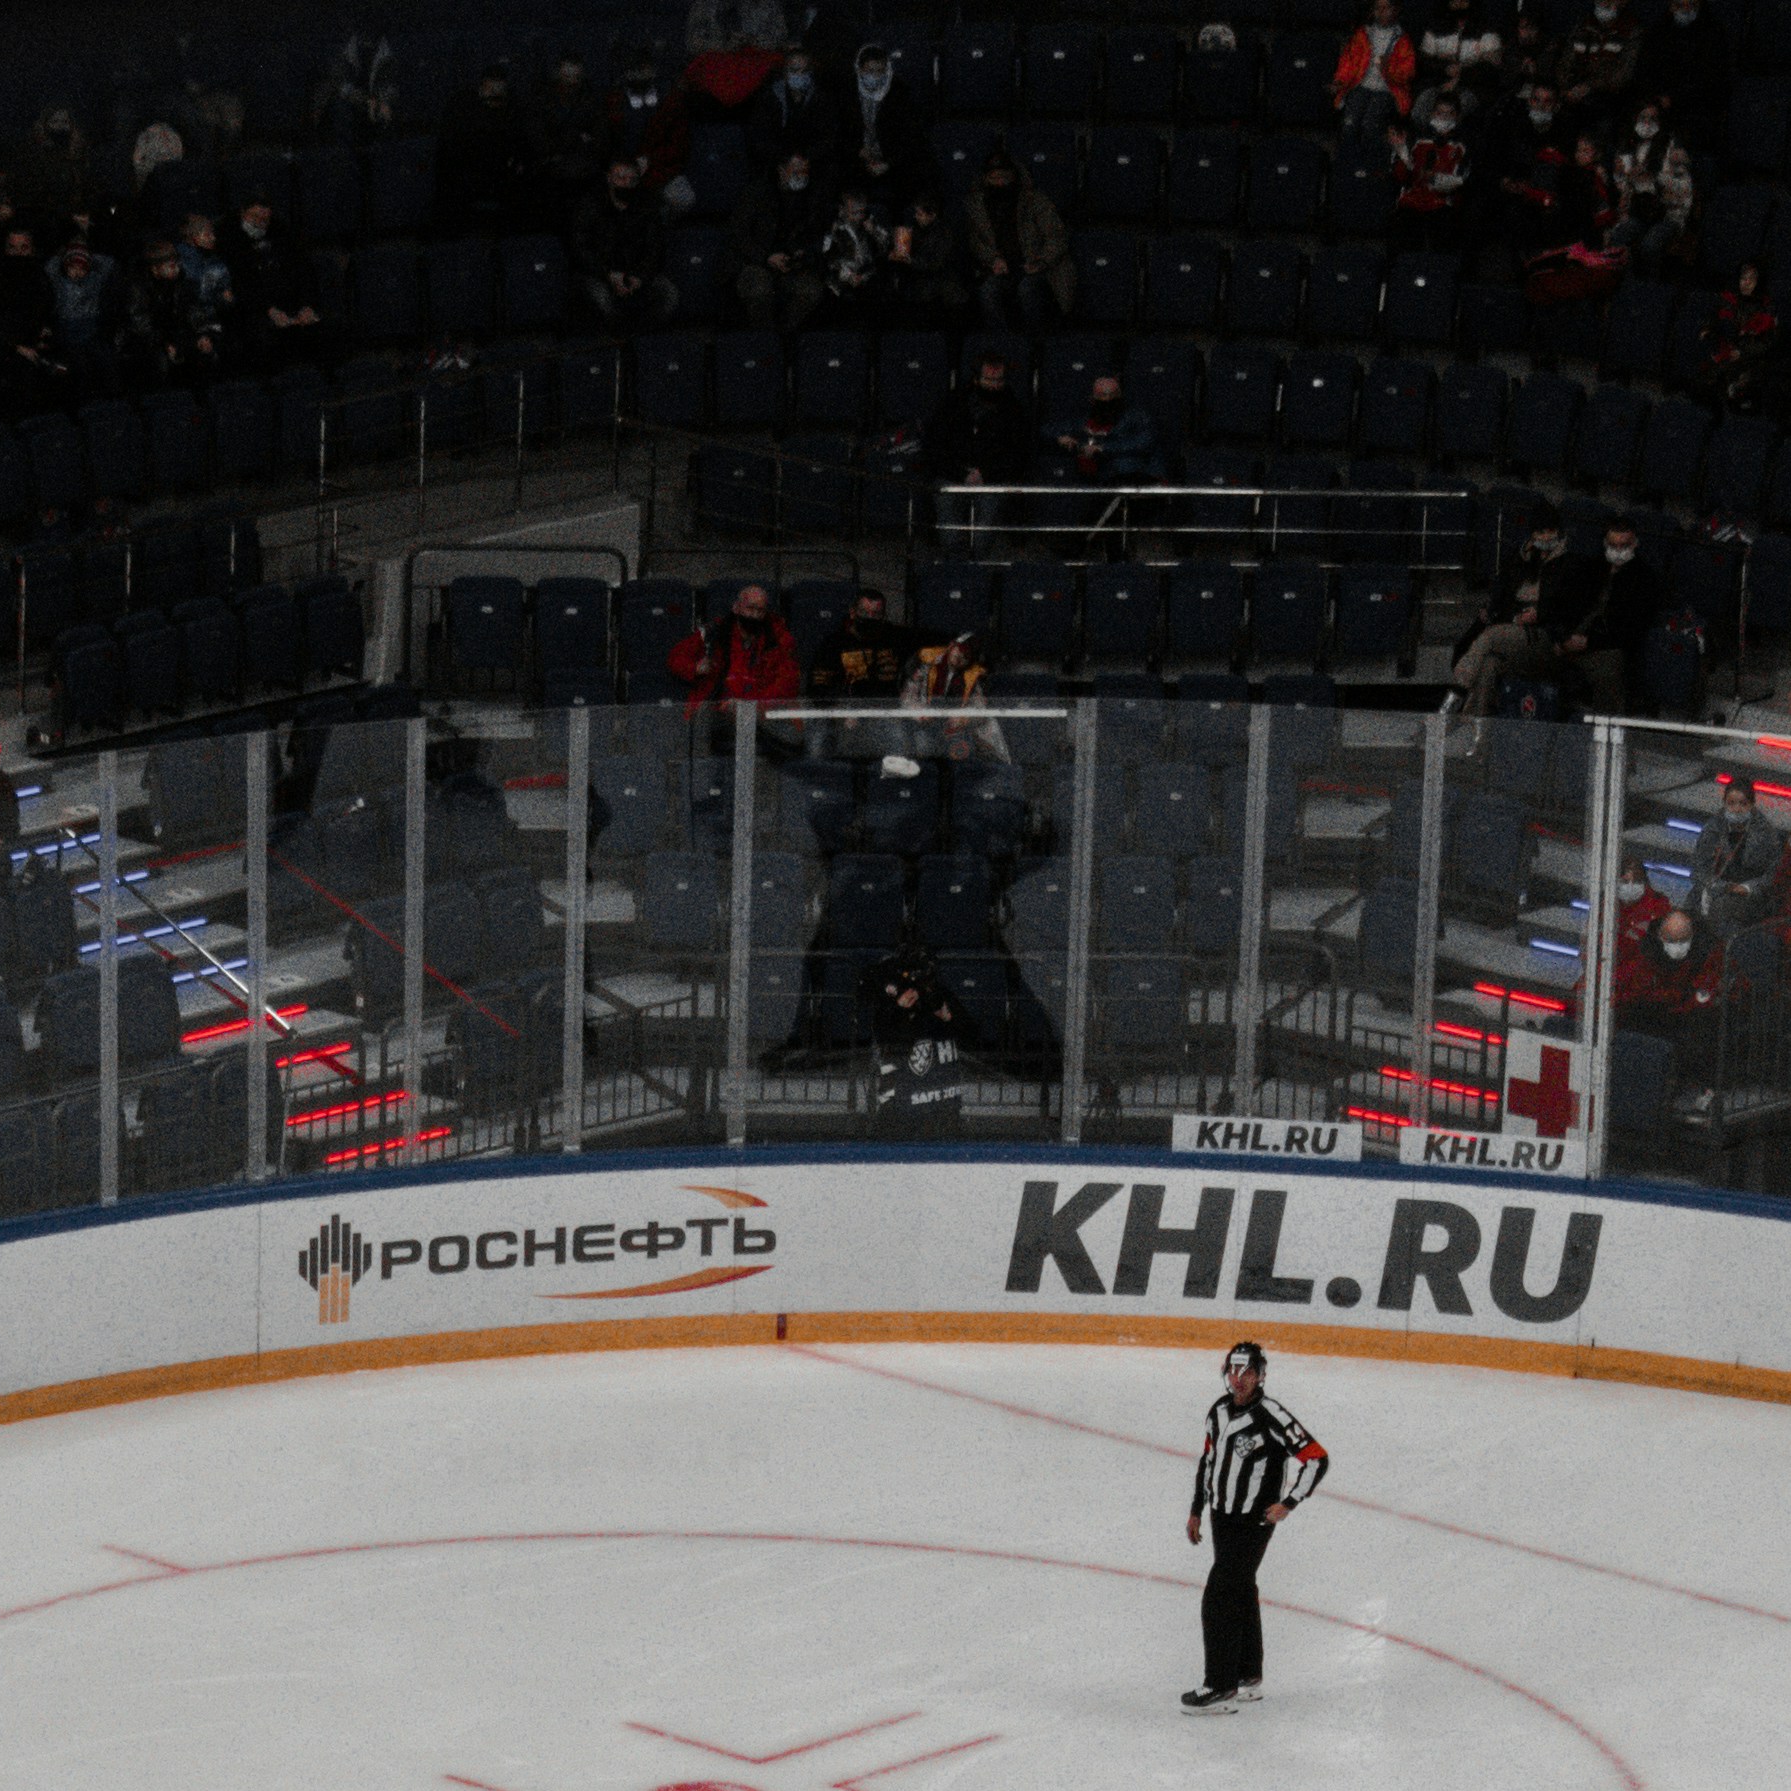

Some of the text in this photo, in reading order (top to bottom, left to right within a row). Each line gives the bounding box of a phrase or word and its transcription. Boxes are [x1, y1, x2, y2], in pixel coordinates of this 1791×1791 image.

[1196, 1120, 1338, 1156] KHL.RU
[1422, 1134, 1565, 1171] KHL.RU
[380, 1216, 777, 1281] РОСНЕФТЬ
[1005, 1180, 1604, 1324] KHL.RU
